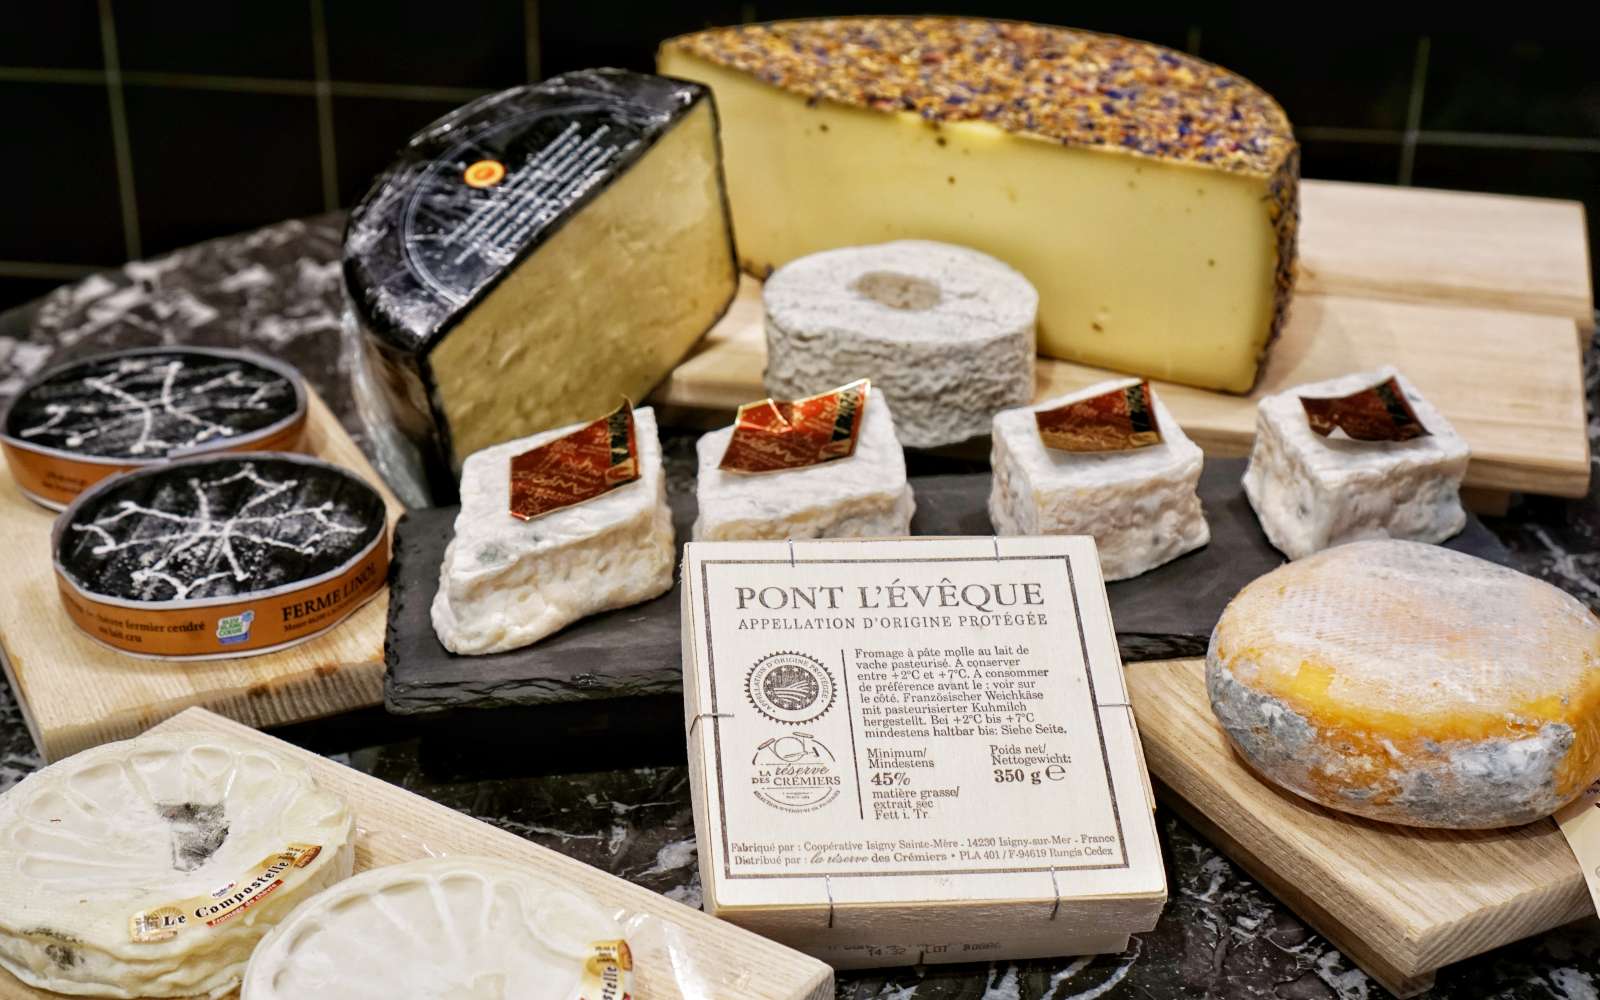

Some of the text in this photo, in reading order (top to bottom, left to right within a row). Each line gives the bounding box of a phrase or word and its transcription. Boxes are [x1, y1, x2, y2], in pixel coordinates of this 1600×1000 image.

[734, 577, 1045, 613] PONT L'ÉVÊQUE
[281, 588, 340, 621] FERME
[738, 612, 1048, 630] APPELLATION D'ORIGINE PROTÉGÉE
[855, 645, 1030, 660] Fromage à pâte molle au lait de
[856, 659, 888, 670] vache
[967, 658, 1021, 668] conserver
[857, 671, 887, 681] entre
[923, 670, 934, 680] et
[985, 669, 1049, 678] consommer
[858, 682, 872, 692] de
[875, 681, 935, 694] préférence
[937, 682, 969, 692] avant
[972, 679, 983, 690] le
[992, 680, 1015, 690] voir
[1018, 680, 1036, 689] sur
[860, 689, 1044, 704] le côté. Französischer Weichkäse
[862, 701, 1027, 716] mit pasteurisierter Kuhmilch
[863, 715, 927, 728] hergestellt.
[930, 715, 949, 725] Bei
[985, 713, 1002, 724] bis
[865, 723, 1067, 738] mindestens haltbar bis: Siehe Seite.
[867, 747, 927, 759] Minimum/
[989, 743, 1022, 755] Poids
[868, 757, 935, 769] Mindestens
[991, 753, 1072, 767] Nettogewicht:
[775, 763, 830, 776] réserve
[993, 768, 1025, 783] 350
[1030, 770, 1042, 785] g
[752, 775, 841, 787] DES CRÉMIERS
[870, 771, 911, 786] 45%
[872, 788, 917, 799] matière
[873, 798, 935, 810] extrait sec
[875, 809, 900, 820] Fett
[731, 842, 776, 854] Fabriqué
[778, 843, 795, 854] par
[803, 840, 863, 852] Coopérative
[867, 840, 896, 851] Isigny
[967, 838, 996, 848] 14230
[1080, 834, 1116, 844] France
[734, 855, 782, 865] Distribué
[784, 857, 801, 867] par
[871, 853, 891, 863] des
[893, 851, 948, 863] Crémiers
[959, 850, 982, 860] PLA
[983, 850, 1001, 860] 401
[1049, 847, 1082, 857] Rungis
[1084, 845, 1113, 856] Cedex
[163, 860, 290, 928] Le Compostelle
